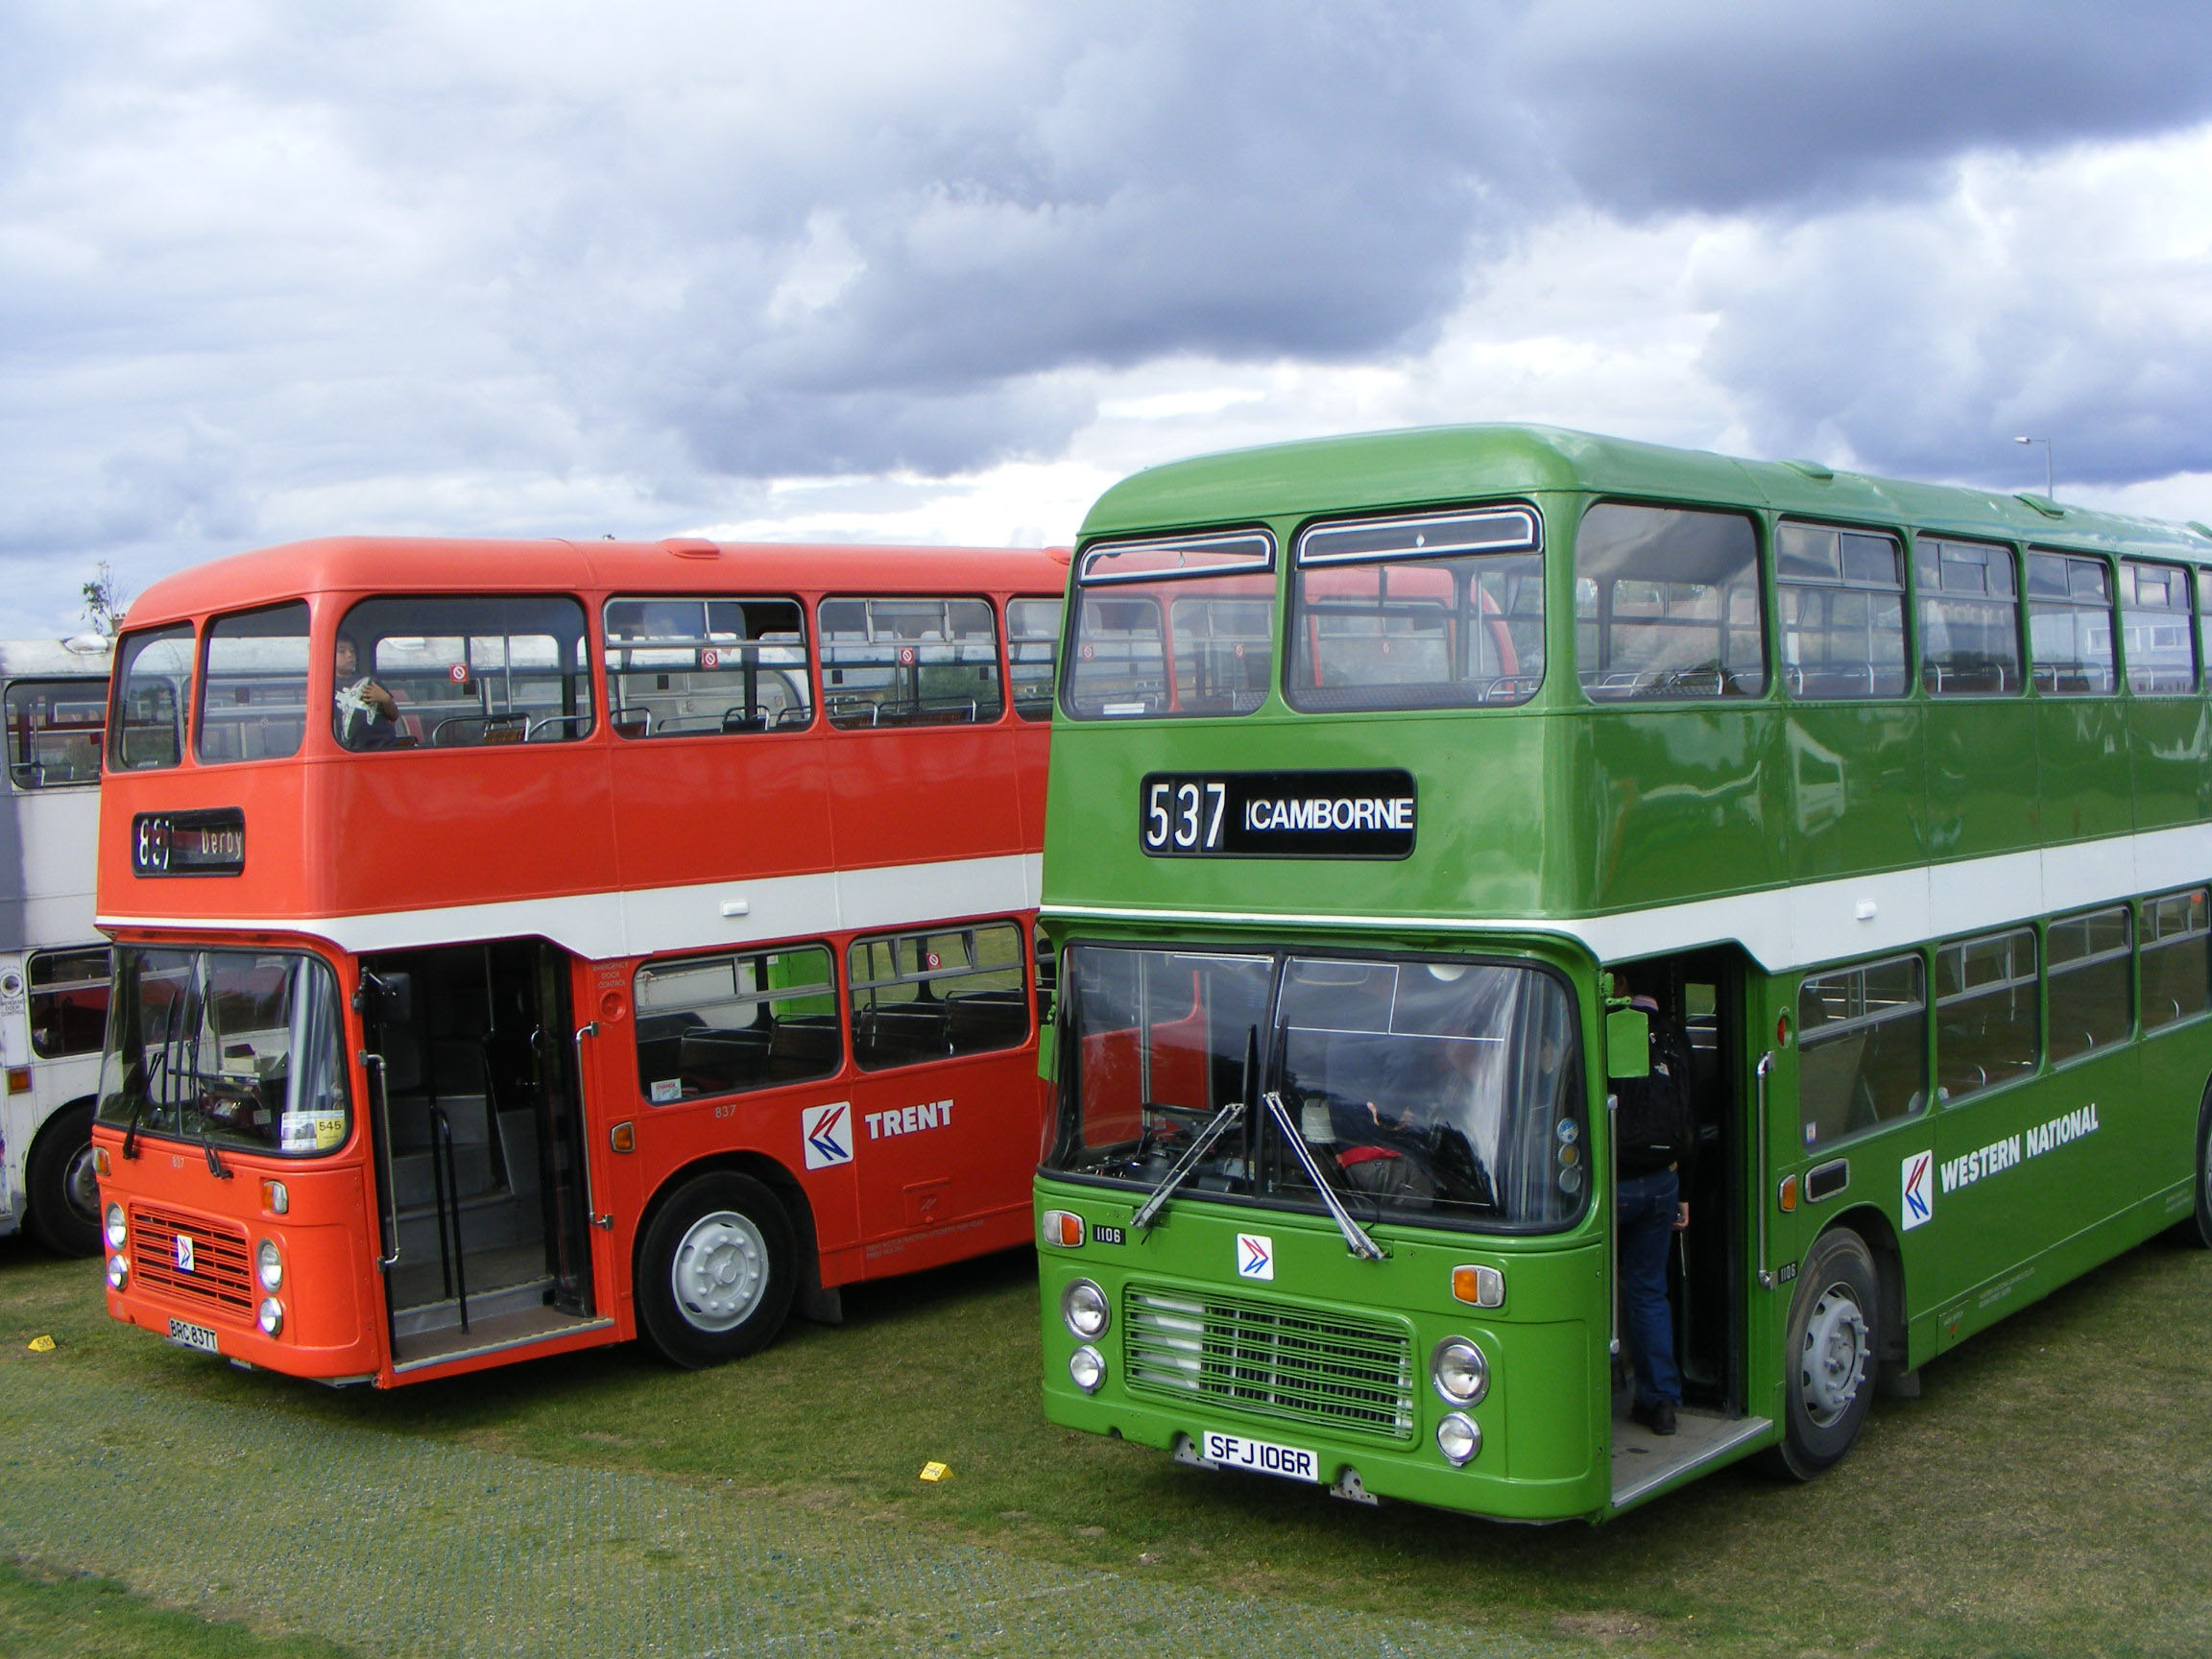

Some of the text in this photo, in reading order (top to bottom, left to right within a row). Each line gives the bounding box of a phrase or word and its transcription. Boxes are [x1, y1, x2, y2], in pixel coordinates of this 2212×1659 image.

[1147, 782, 1226, 848] 537
[202, 828, 242, 859] Derby
[319, 1121, 342, 1131] 545
[714, 1105, 737, 1118] 837
[865, 1099, 953, 1140] TRENT
[1940, 1103, 2099, 1193] WESTERN NATIONAL
[1096, 1227, 1120, 1243] 1106
